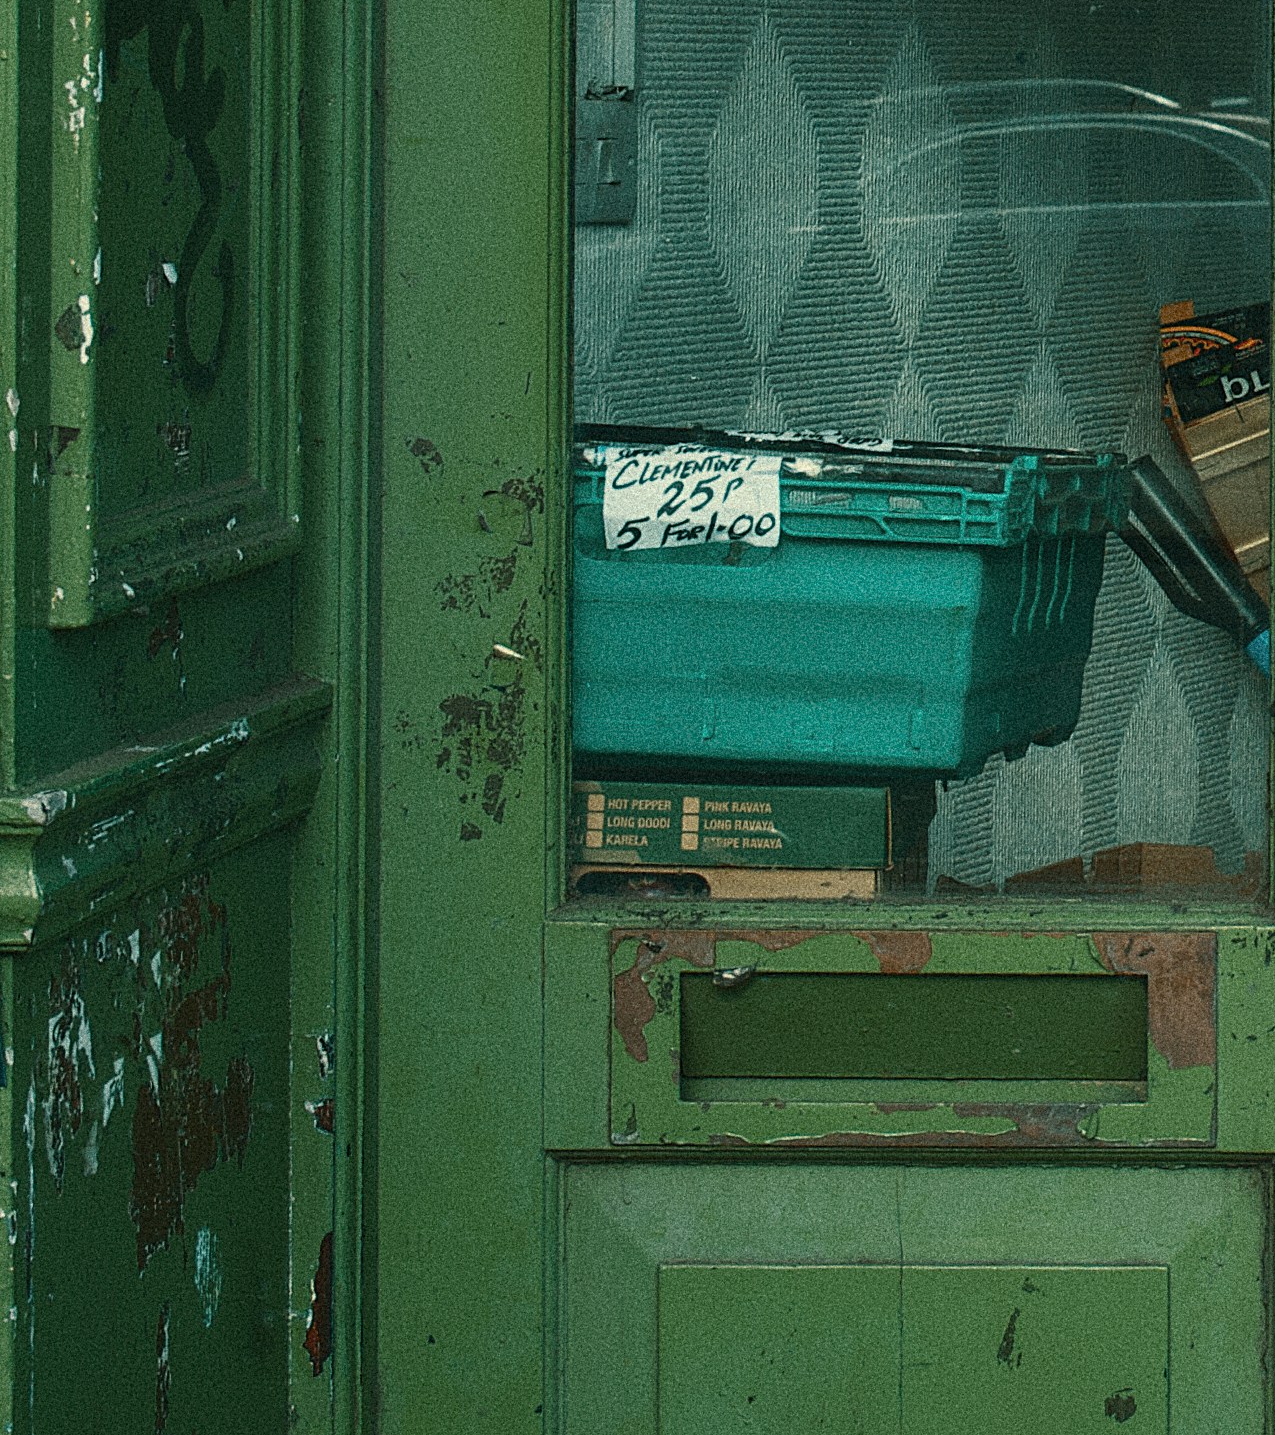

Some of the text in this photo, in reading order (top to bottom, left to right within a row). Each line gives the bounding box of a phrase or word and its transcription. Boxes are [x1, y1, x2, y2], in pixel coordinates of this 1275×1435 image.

[616, 515, 650, 550] 5
[660, 518, 705, 546] FOR
[607, 798, 672, 811] HOT PEPPER
[704, 801, 772, 814] PINK RAVAYA
[607, 816, 635, 829] LONG
[703, 818, 775, 832] LONG RAVAYA
[606, 833, 649, 847] KARELA
[741, 837, 783, 850] RAVAYA
